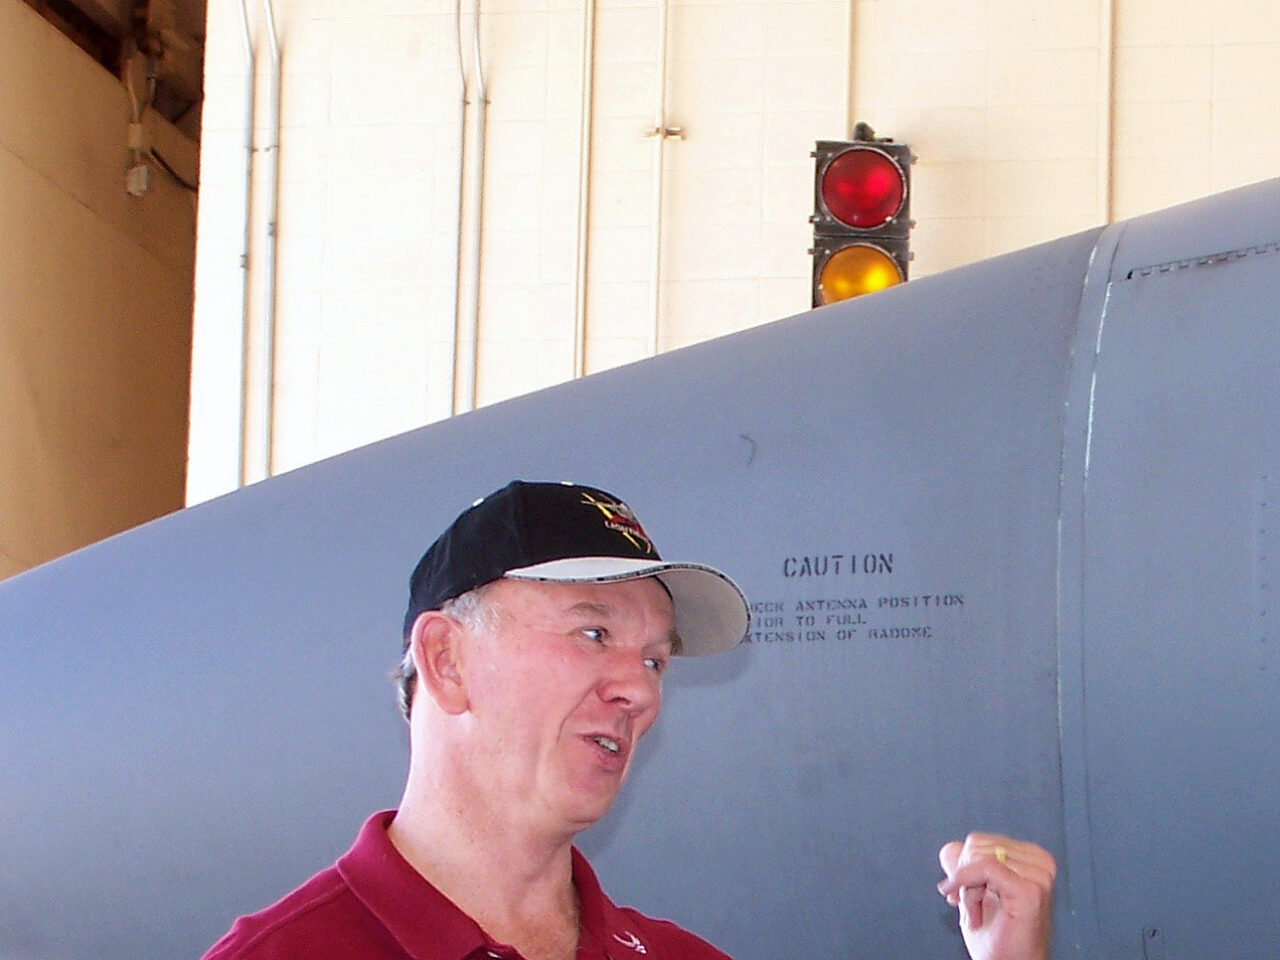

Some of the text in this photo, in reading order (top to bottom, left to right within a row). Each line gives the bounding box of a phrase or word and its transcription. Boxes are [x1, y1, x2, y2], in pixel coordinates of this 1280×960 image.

[783, 552, 894, 578] CAUTION
[750, 594, 965, 614] ECK ANTENNA POSITION
[756, 613, 867, 629] IOR TO FULL
[743, 625, 933, 644] XTENSION OF RADOME
